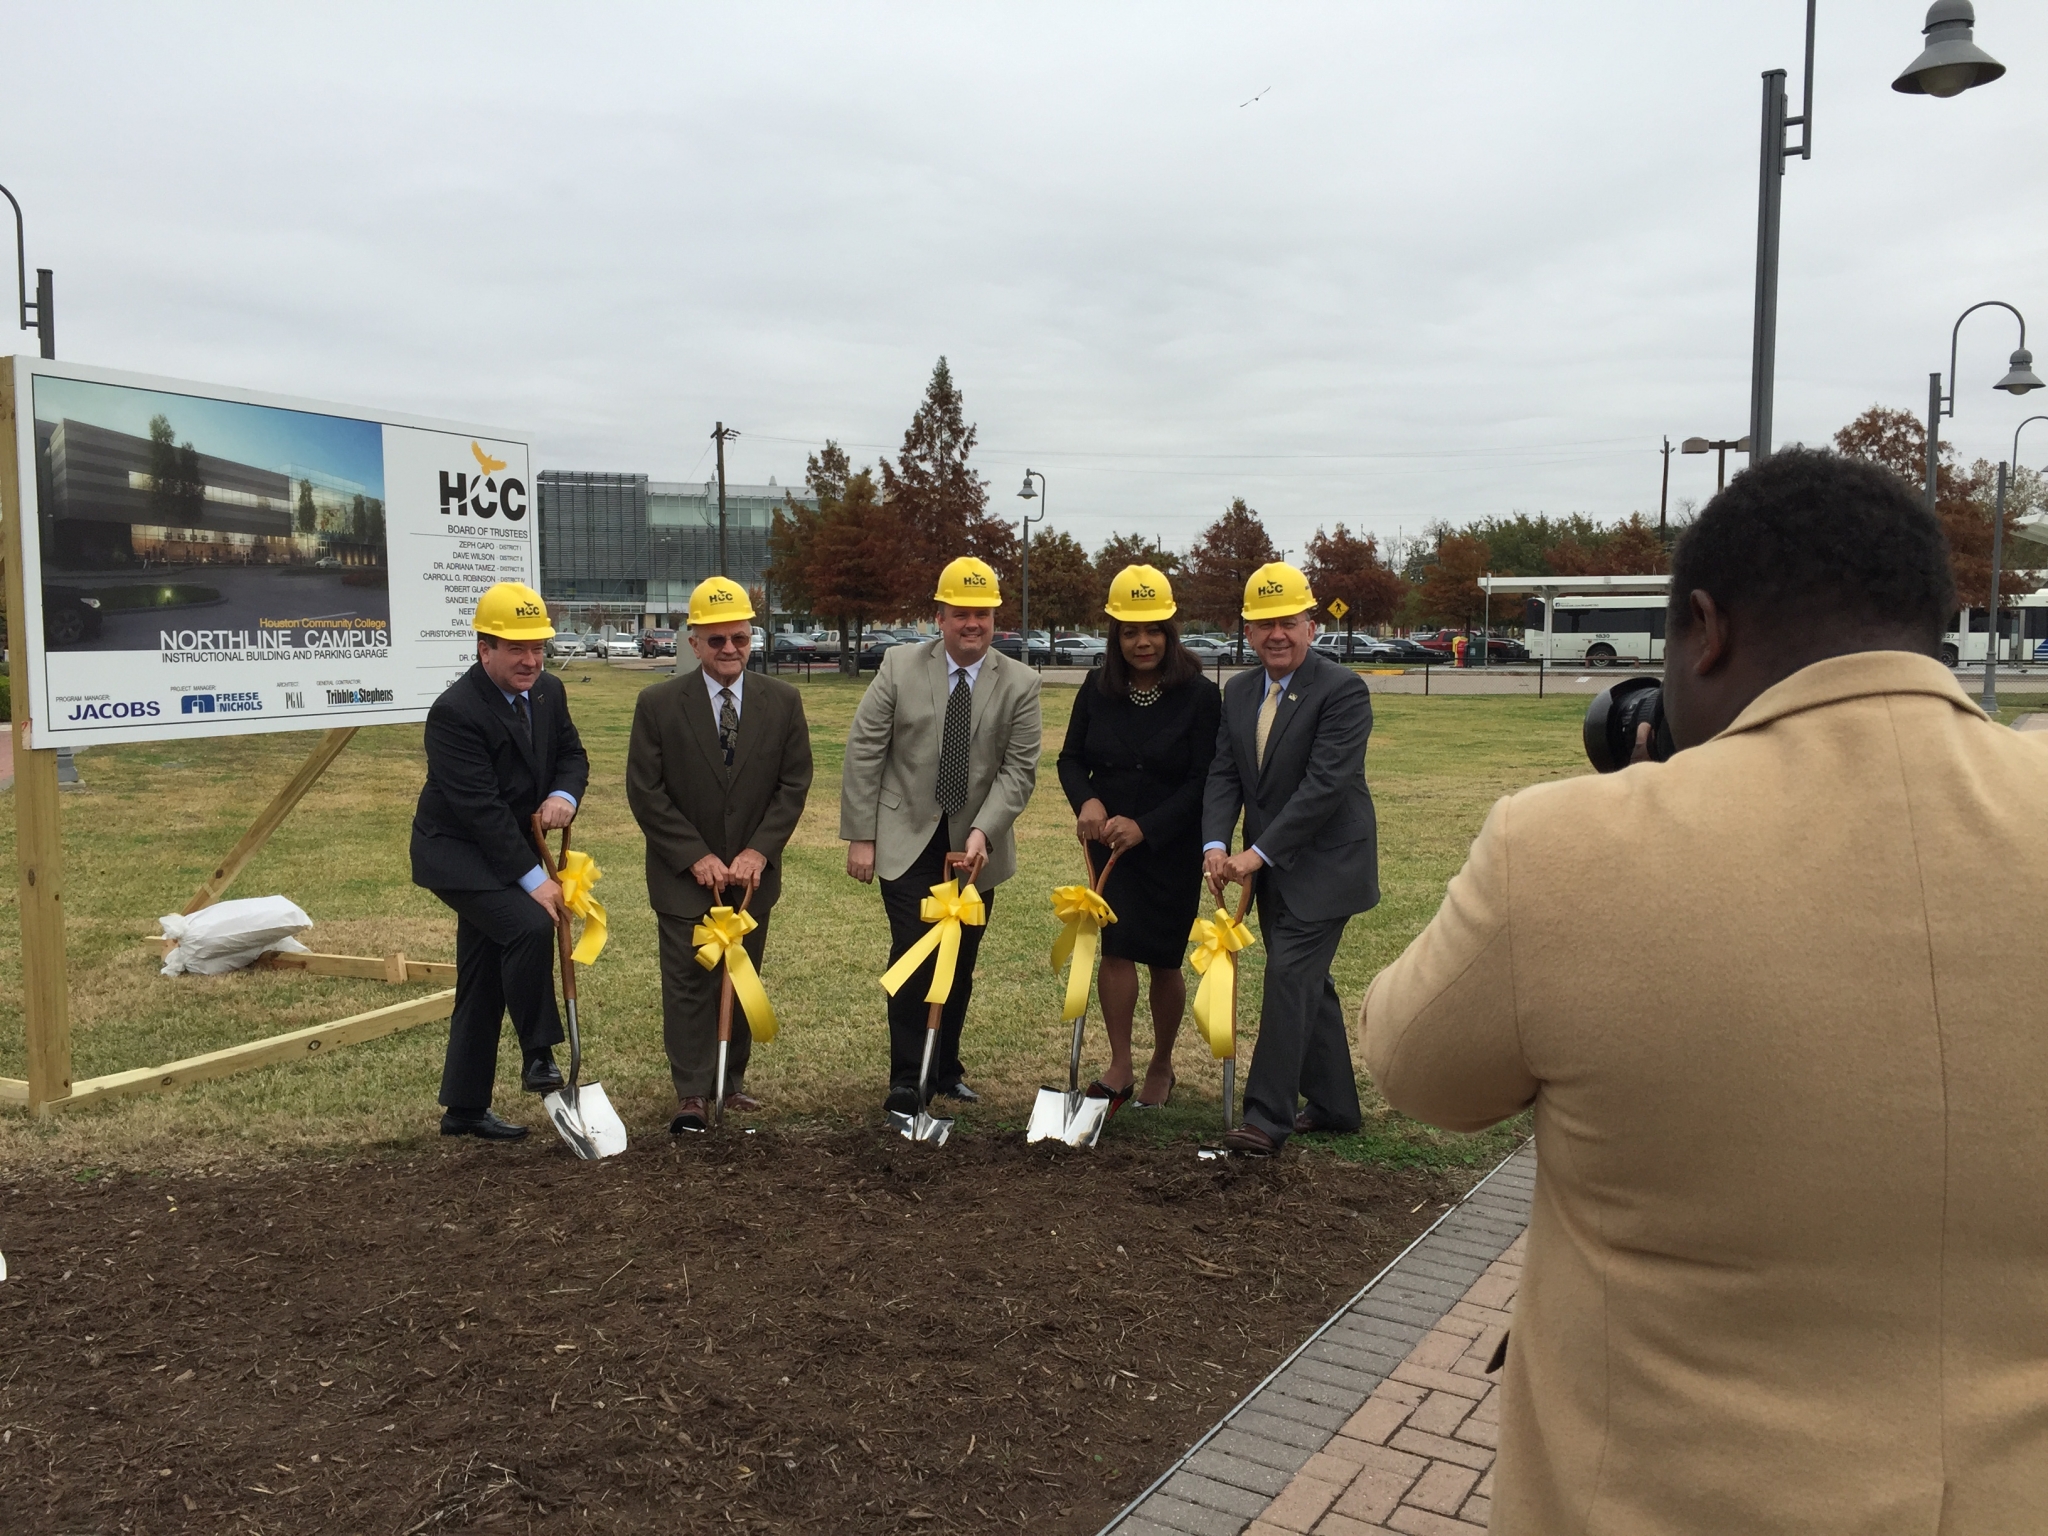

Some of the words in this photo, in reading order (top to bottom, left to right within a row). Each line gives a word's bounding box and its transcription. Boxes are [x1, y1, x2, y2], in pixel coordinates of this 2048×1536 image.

[439, 470, 526, 521] HCC
[447, 525, 476, 535] BOARD
[477, 527, 489, 536] OF
[489, 528, 528, 539] TRUSTEES
[459, 541, 476, 549] ZEPH
[476, 542, 495, 550] CAPO
[452, 552, 470, 560] DAVE
[470, 553, 495, 561] WILSON
[433, 562, 444, 570] DR.
[445, 562, 474, 571] ADRIANA
[474, 564, 496, 572] TAMEZ
[422, 573, 453, 582] CARROLL
[462, 575, 496, 583] ROBINSON
[963, 576, 987, 586] HCC
[444, 585, 470, 593] ROBERT
[1131, 588, 1156, 599] HCC
[1257, 584, 1284, 596] HCC
[445, 596, 469, 605] SANDIE
[708, 592, 733, 604] HCC
[515, 605, 540, 617] HCC
[259, 617, 299, 628] Houston
[301, 617, 353, 630] Community
[354, 617, 387, 630] College
[451, 619, 465, 627] EVA
[160, 630, 292, 651] NORTHLINE
[304, 629, 389, 649] CAMPUS
[420, 630, 467, 638] CHRISTOPHER
[162, 652, 245, 664] INSTRUCTIONAL
[245, 651, 291, 661] BUILDING
[292, 650, 313, 660] AND
[314, 649, 352, 660] PARKING
[353, 648, 389, 659] GARAGE
[216, 692, 259, 702] FREESE
[285, 691, 305, 710] PGAL
[326, 687, 394, 705] Tribble&Stephens
[67, 700, 161, 721] JACOBS
[219, 701, 263, 713] NICHOLS
